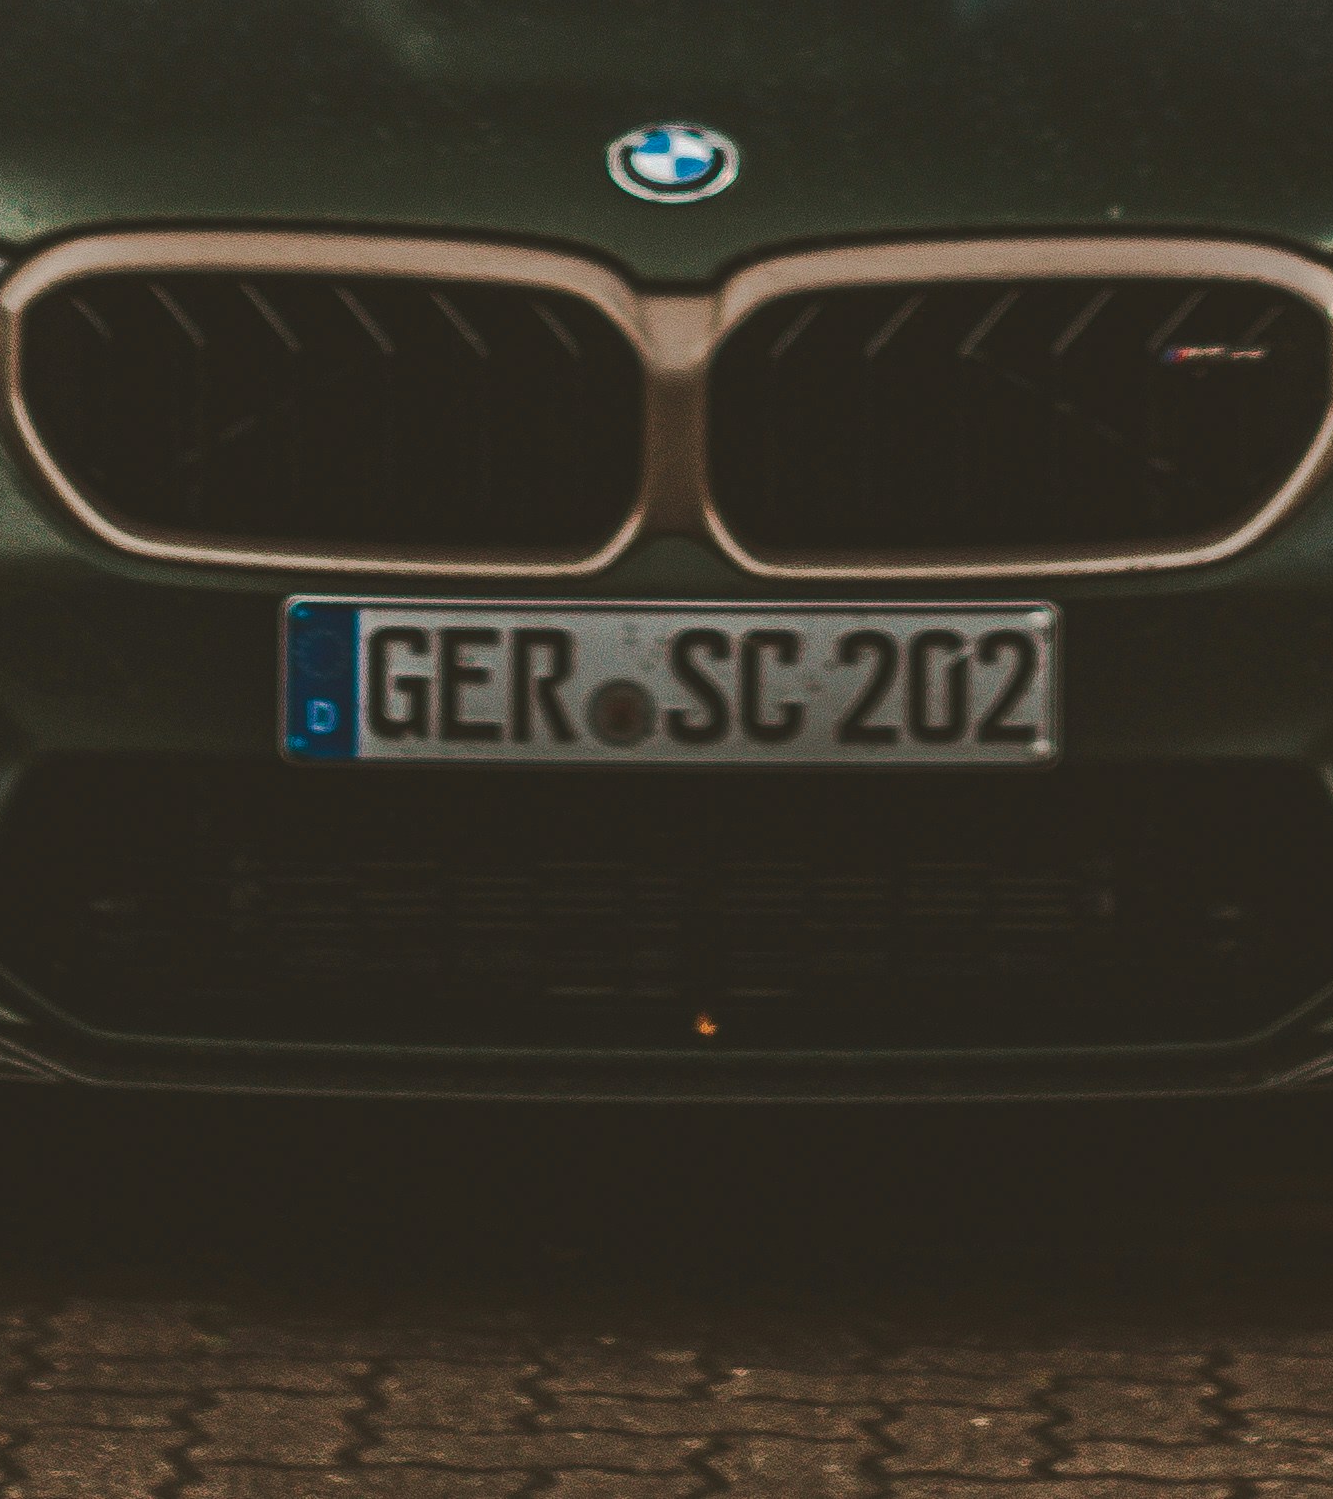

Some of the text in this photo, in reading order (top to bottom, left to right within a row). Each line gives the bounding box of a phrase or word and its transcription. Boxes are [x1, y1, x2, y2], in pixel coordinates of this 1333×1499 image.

[368, 625, 1041, 746] GER SC 202
